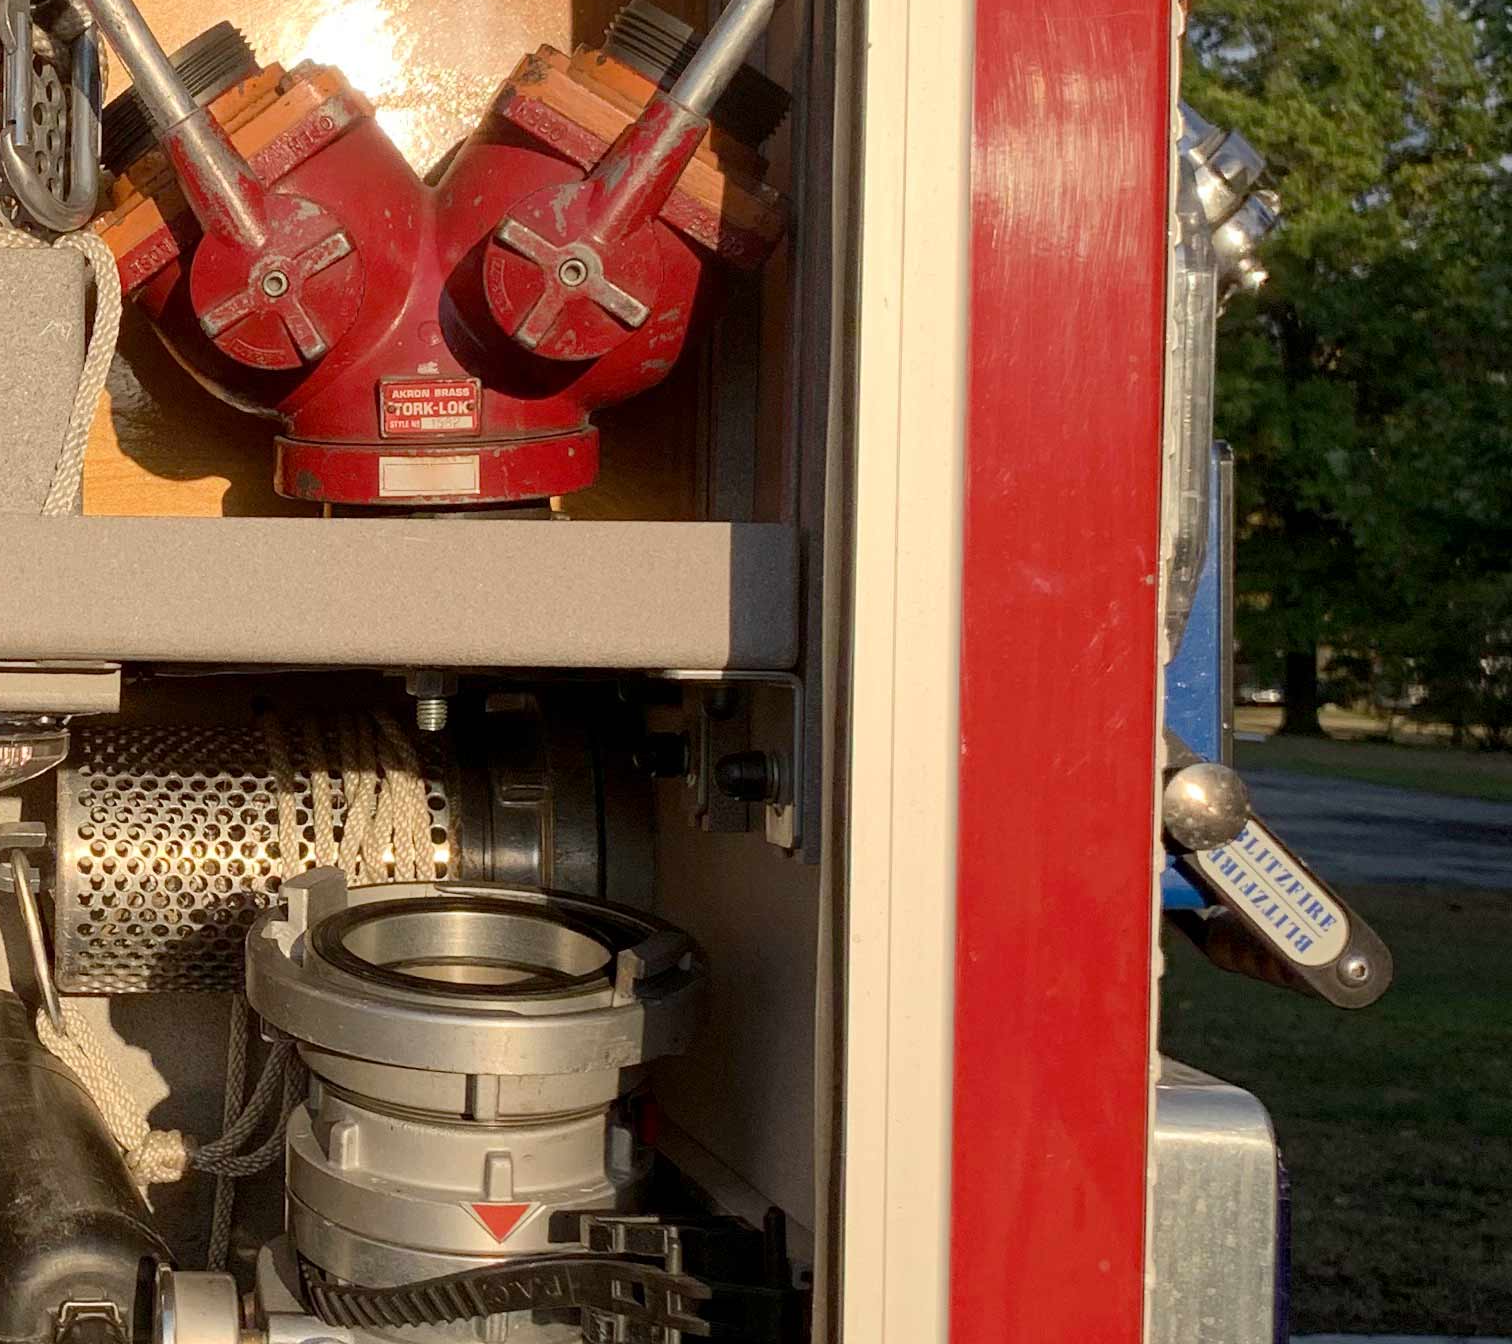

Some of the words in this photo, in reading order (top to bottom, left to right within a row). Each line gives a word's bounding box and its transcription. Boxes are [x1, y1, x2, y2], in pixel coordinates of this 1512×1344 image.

[392, 389, 430, 398] AKRON
[433, 388, 470, 398] BRASS
[394, 400, 469, 416] TORK-LOK
